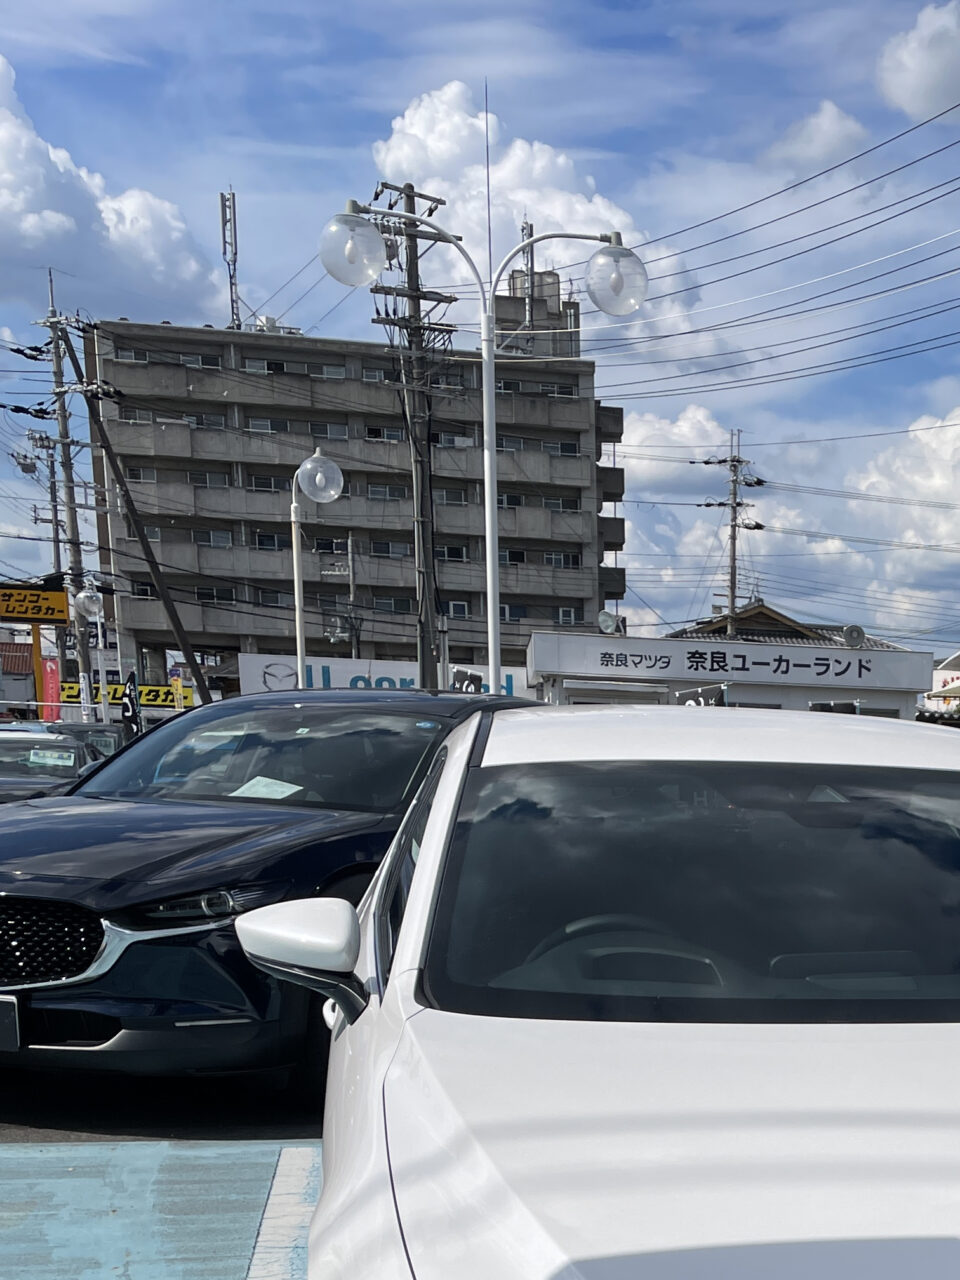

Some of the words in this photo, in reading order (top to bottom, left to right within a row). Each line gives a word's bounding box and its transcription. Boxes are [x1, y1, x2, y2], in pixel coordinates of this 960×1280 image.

[1, 592, 49, 603] サンコー
[5, 604, 65, 616] レンタカー
[599, 652, 672, 671] 奈良マツダ
[686, 650, 873, 679] 奈良ユーカーランド
